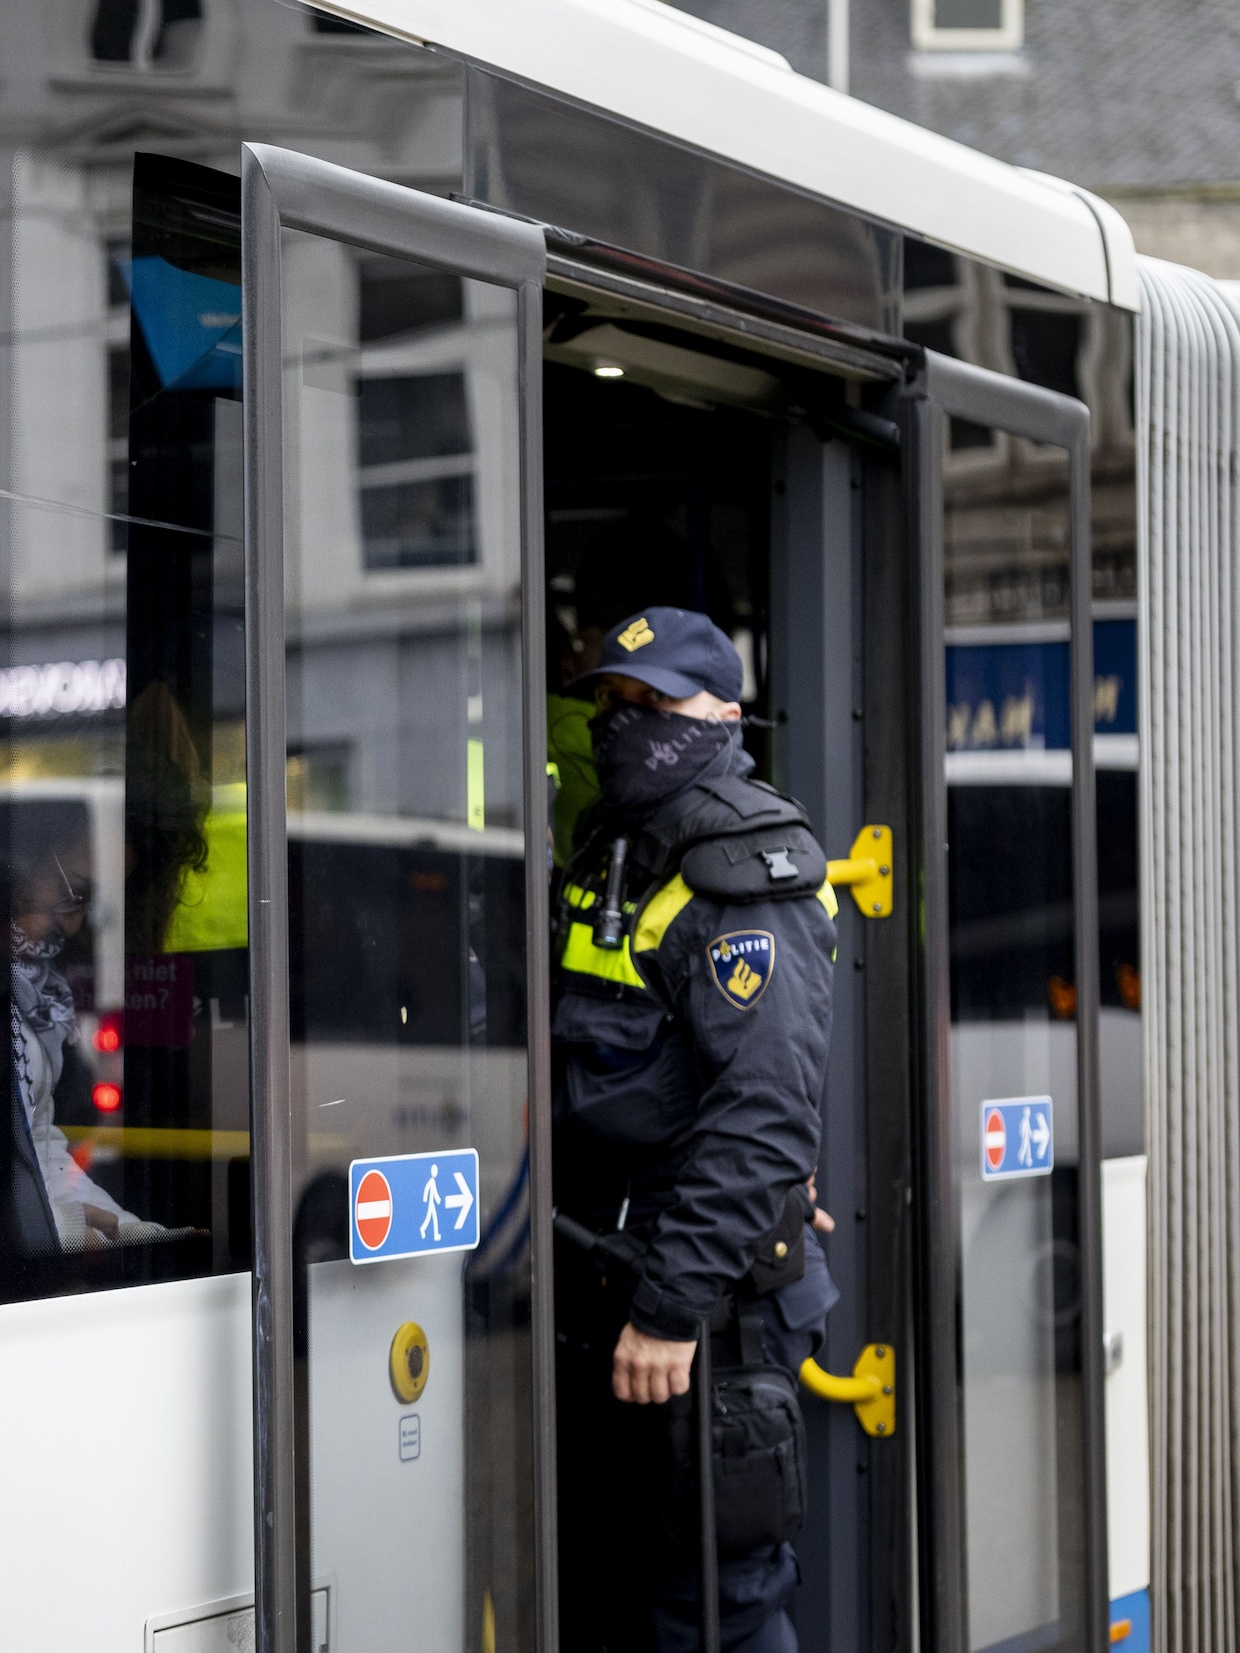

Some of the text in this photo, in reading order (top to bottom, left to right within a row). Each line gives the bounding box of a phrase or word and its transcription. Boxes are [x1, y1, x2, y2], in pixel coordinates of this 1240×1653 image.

[711, 938, 769, 963] POLITIE
[132, 958, 178, 982] niet
[124, 986, 171, 1014] en?
